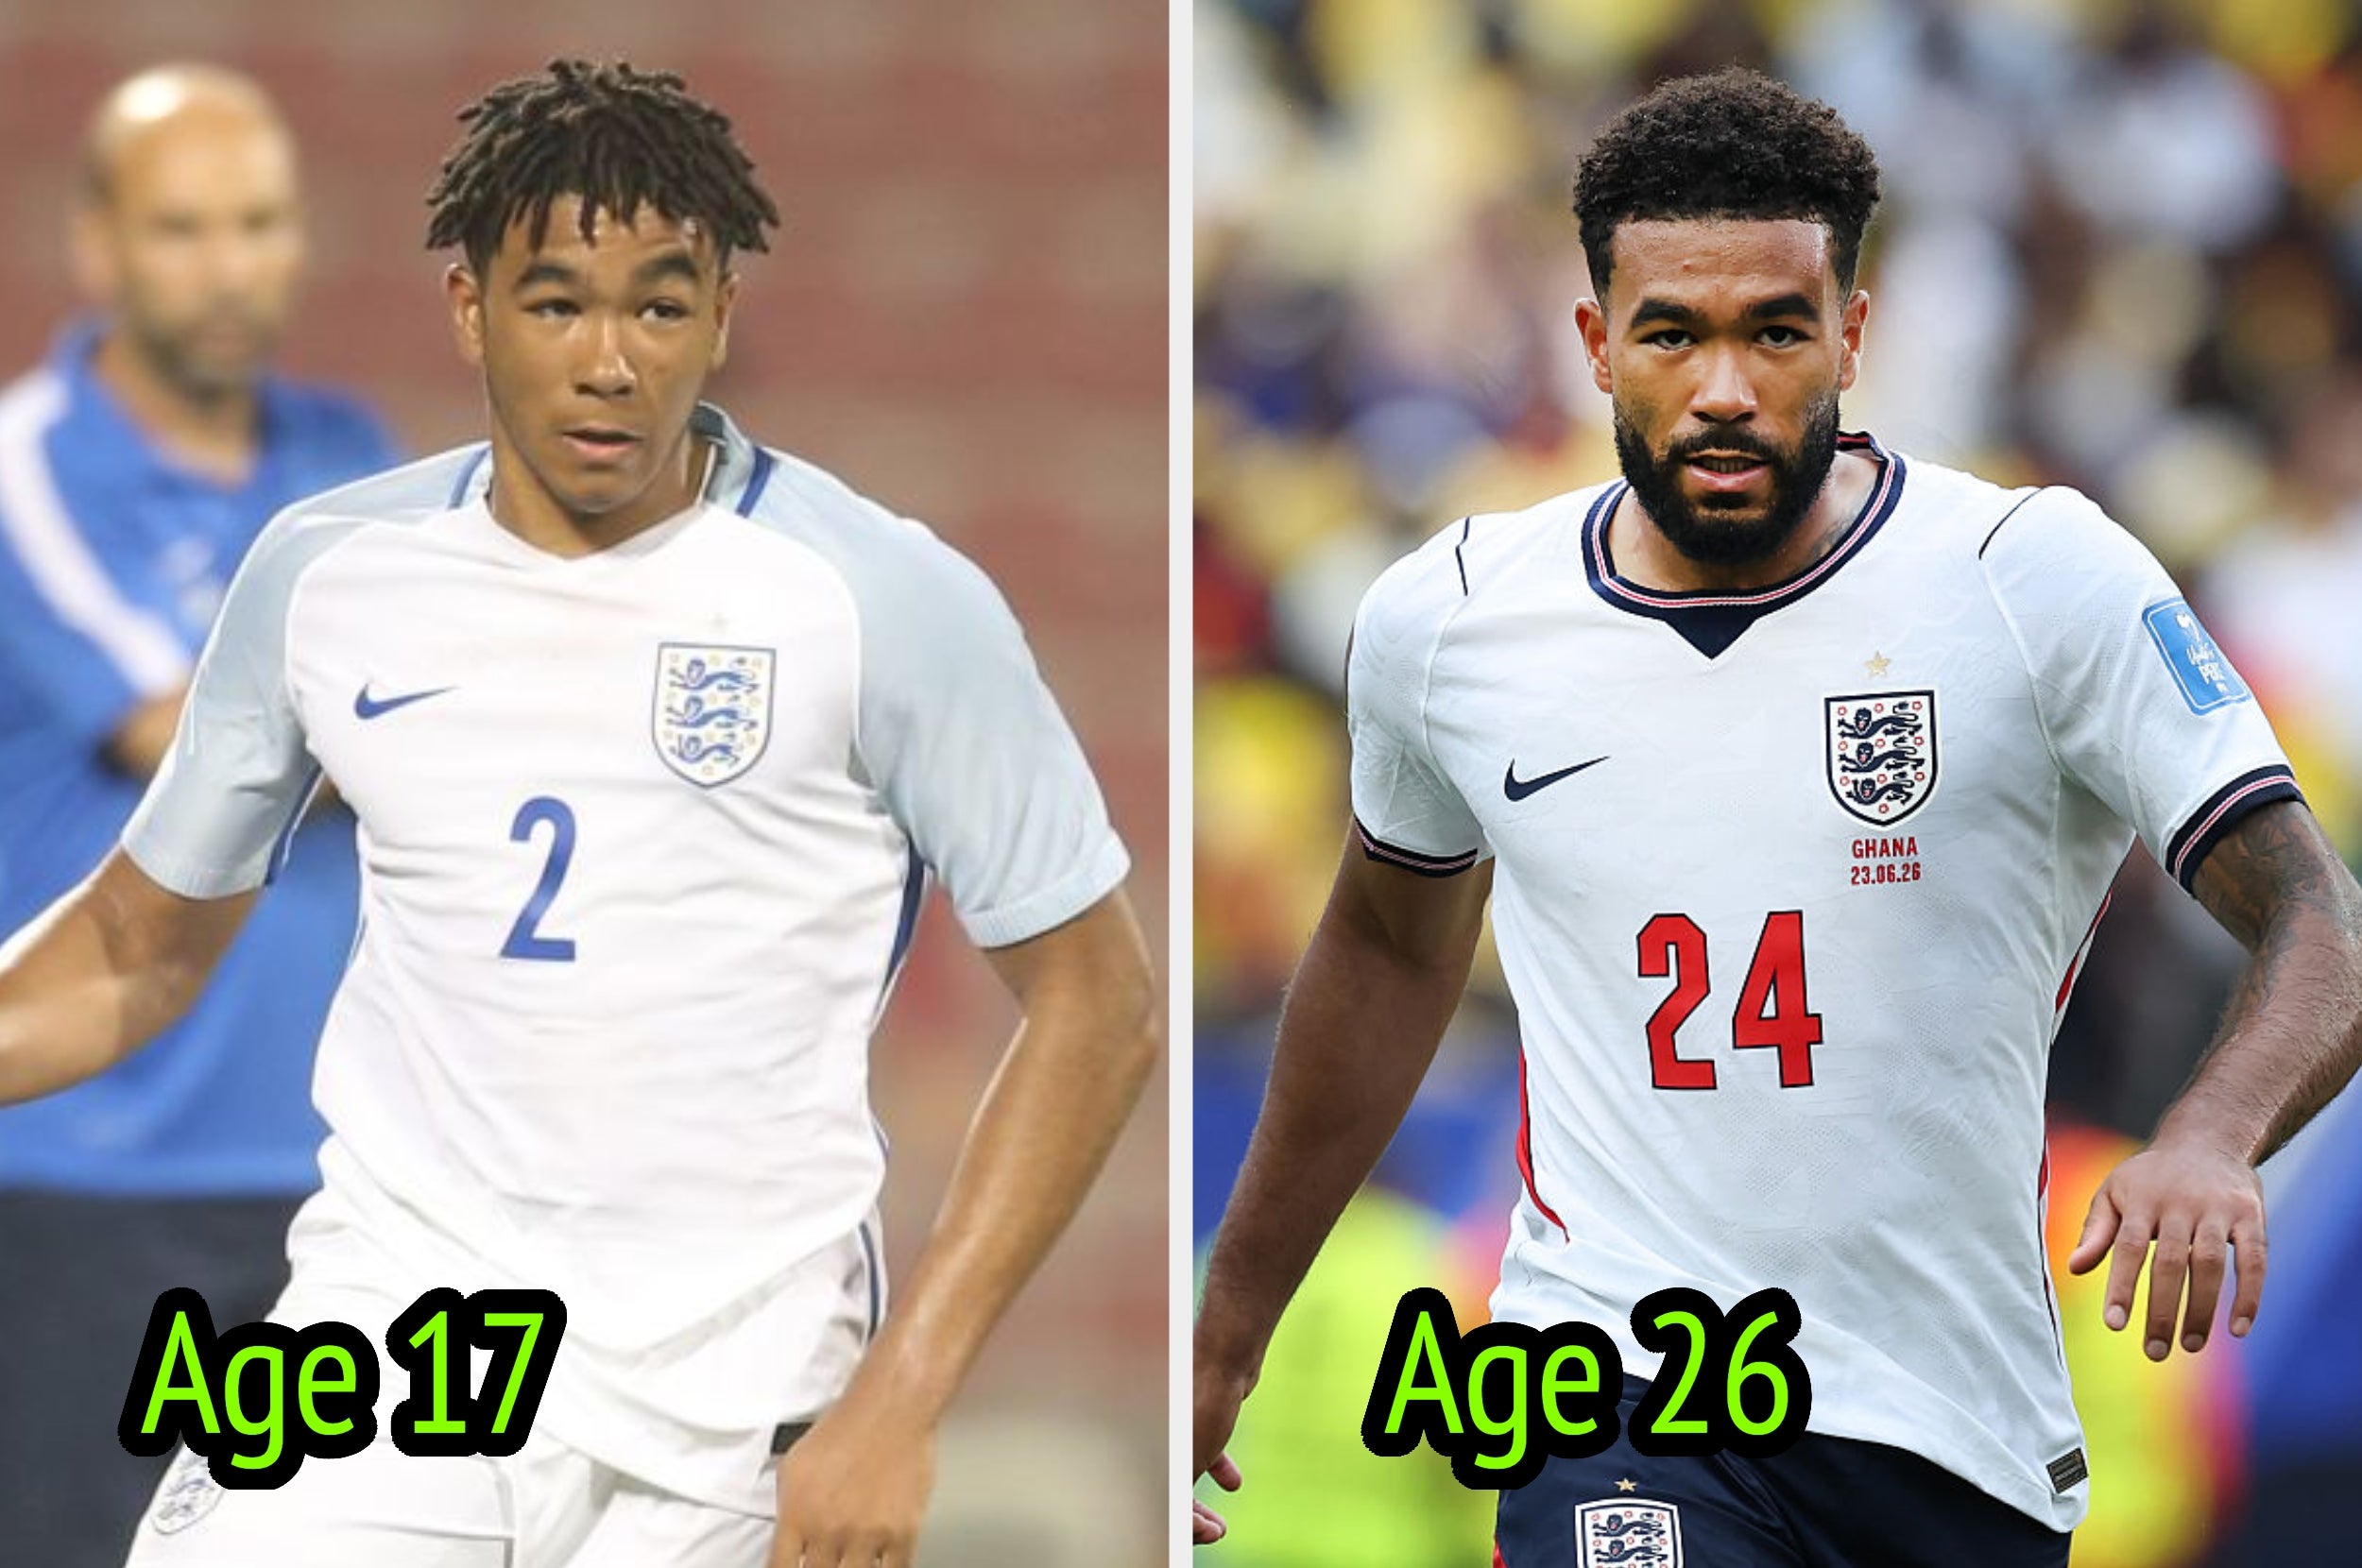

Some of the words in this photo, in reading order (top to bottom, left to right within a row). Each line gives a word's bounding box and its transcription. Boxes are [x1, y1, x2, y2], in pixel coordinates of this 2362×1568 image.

[500, 795, 577, 963] 2
[1850, 861, 1922, 886] 23.06.26
[1851, 836, 1918, 860] GHANA
[1635, 909, 1824, 1090] 24
